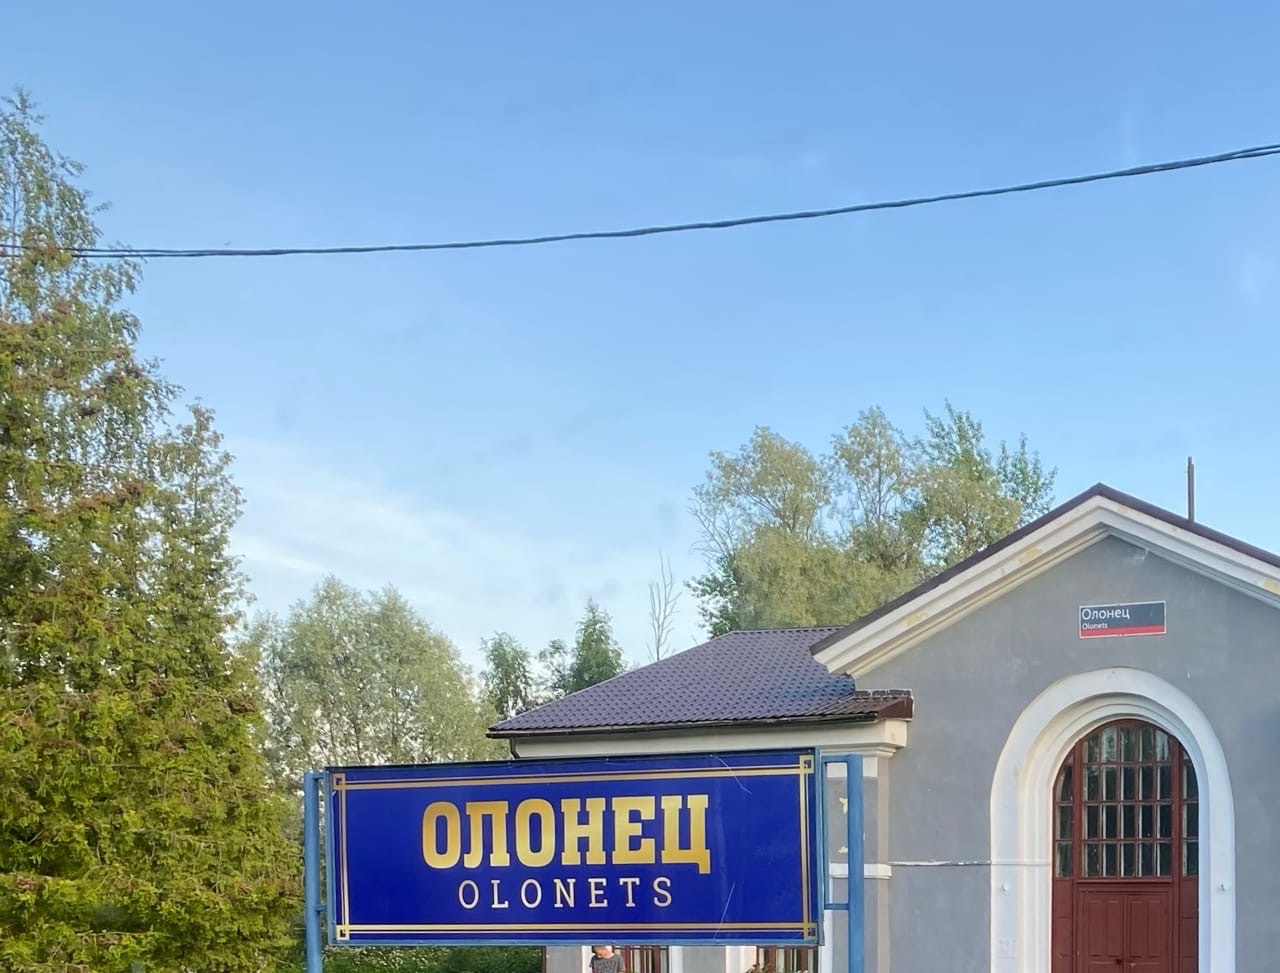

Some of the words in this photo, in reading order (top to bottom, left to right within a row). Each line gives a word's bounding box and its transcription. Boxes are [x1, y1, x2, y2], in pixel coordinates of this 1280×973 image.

[1081, 608, 1130, 620] Олонец
[1081, 622, 1108, 630] Olonets
[422, 794, 711, 875] ОЛОНЕЦ
[458, 877, 673, 909] OLONETS
